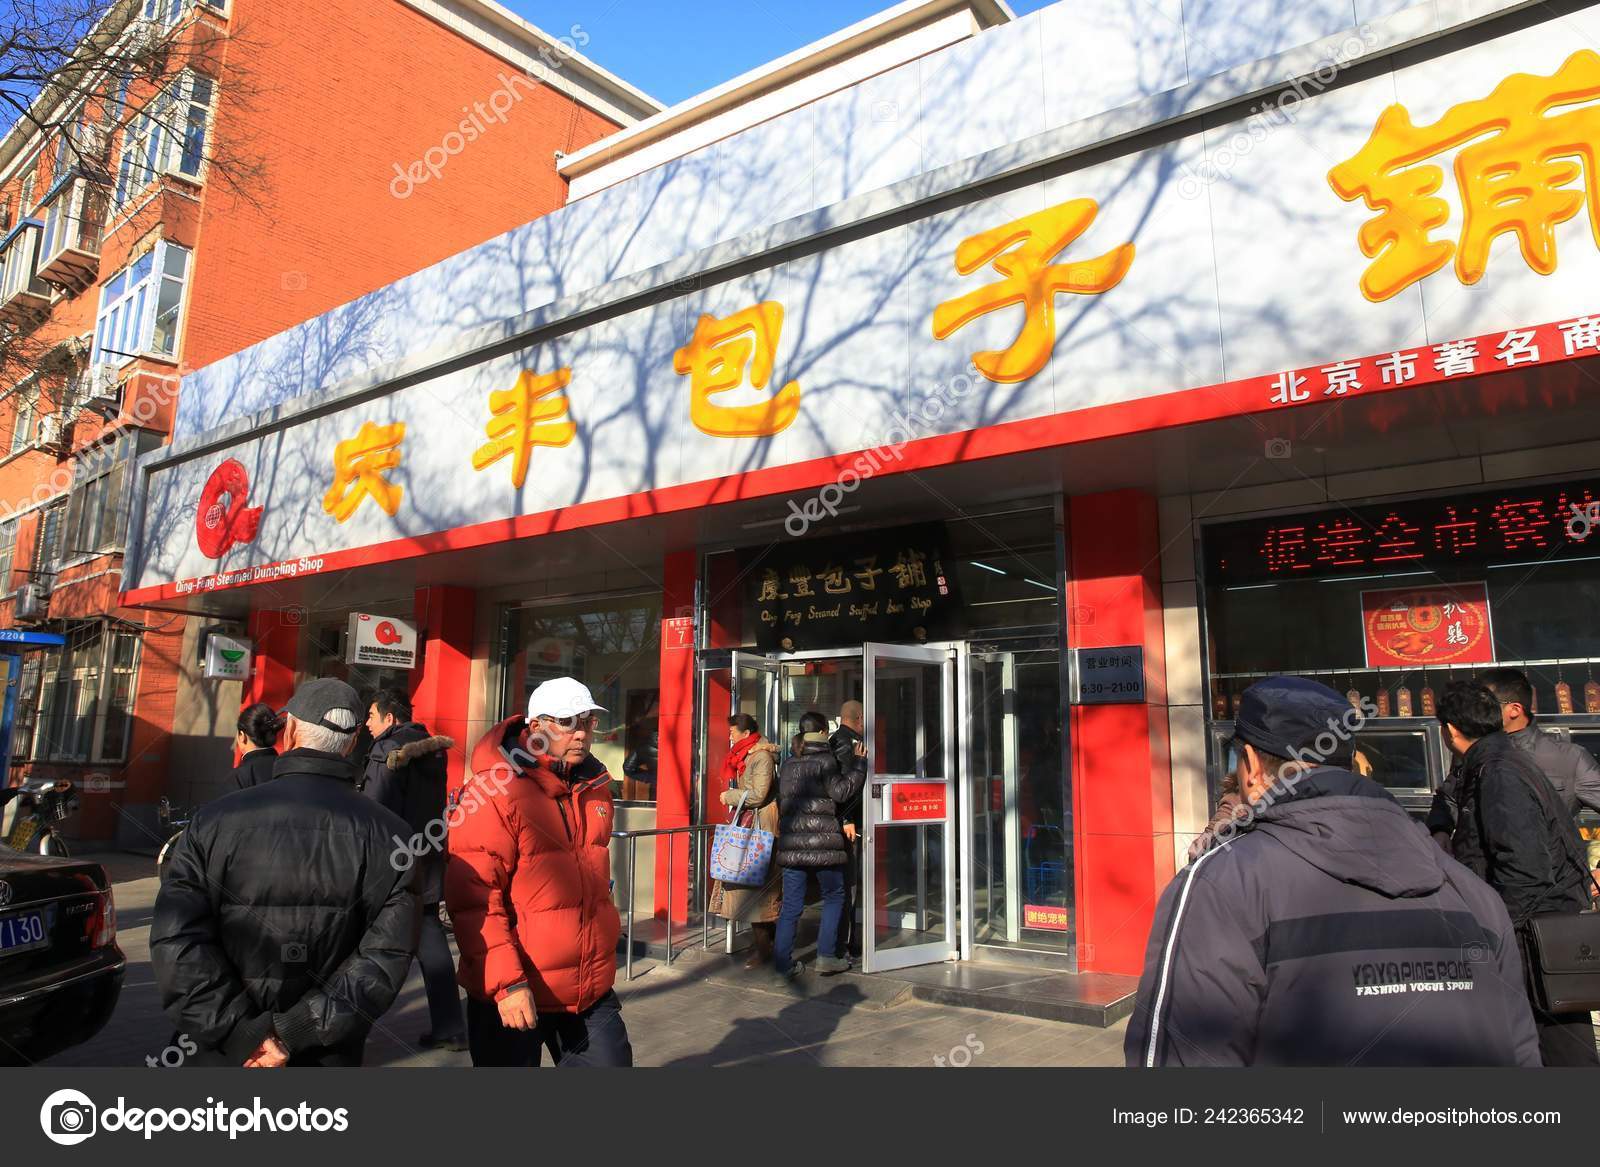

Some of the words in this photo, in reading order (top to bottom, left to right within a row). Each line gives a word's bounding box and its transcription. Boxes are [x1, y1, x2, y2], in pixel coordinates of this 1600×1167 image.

[176, 577, 215, 593] Qing-Feng
[216, 568, 253, 586] Steamed
[254, 562, 297, 580] Dumpling
[298, 556, 324, 573] Shop
[1086, 655, 1132, 669] 营业时间
[1355, 983, 1407, 996] FASHION
[1409, 982, 1445, 992] VOGUE
